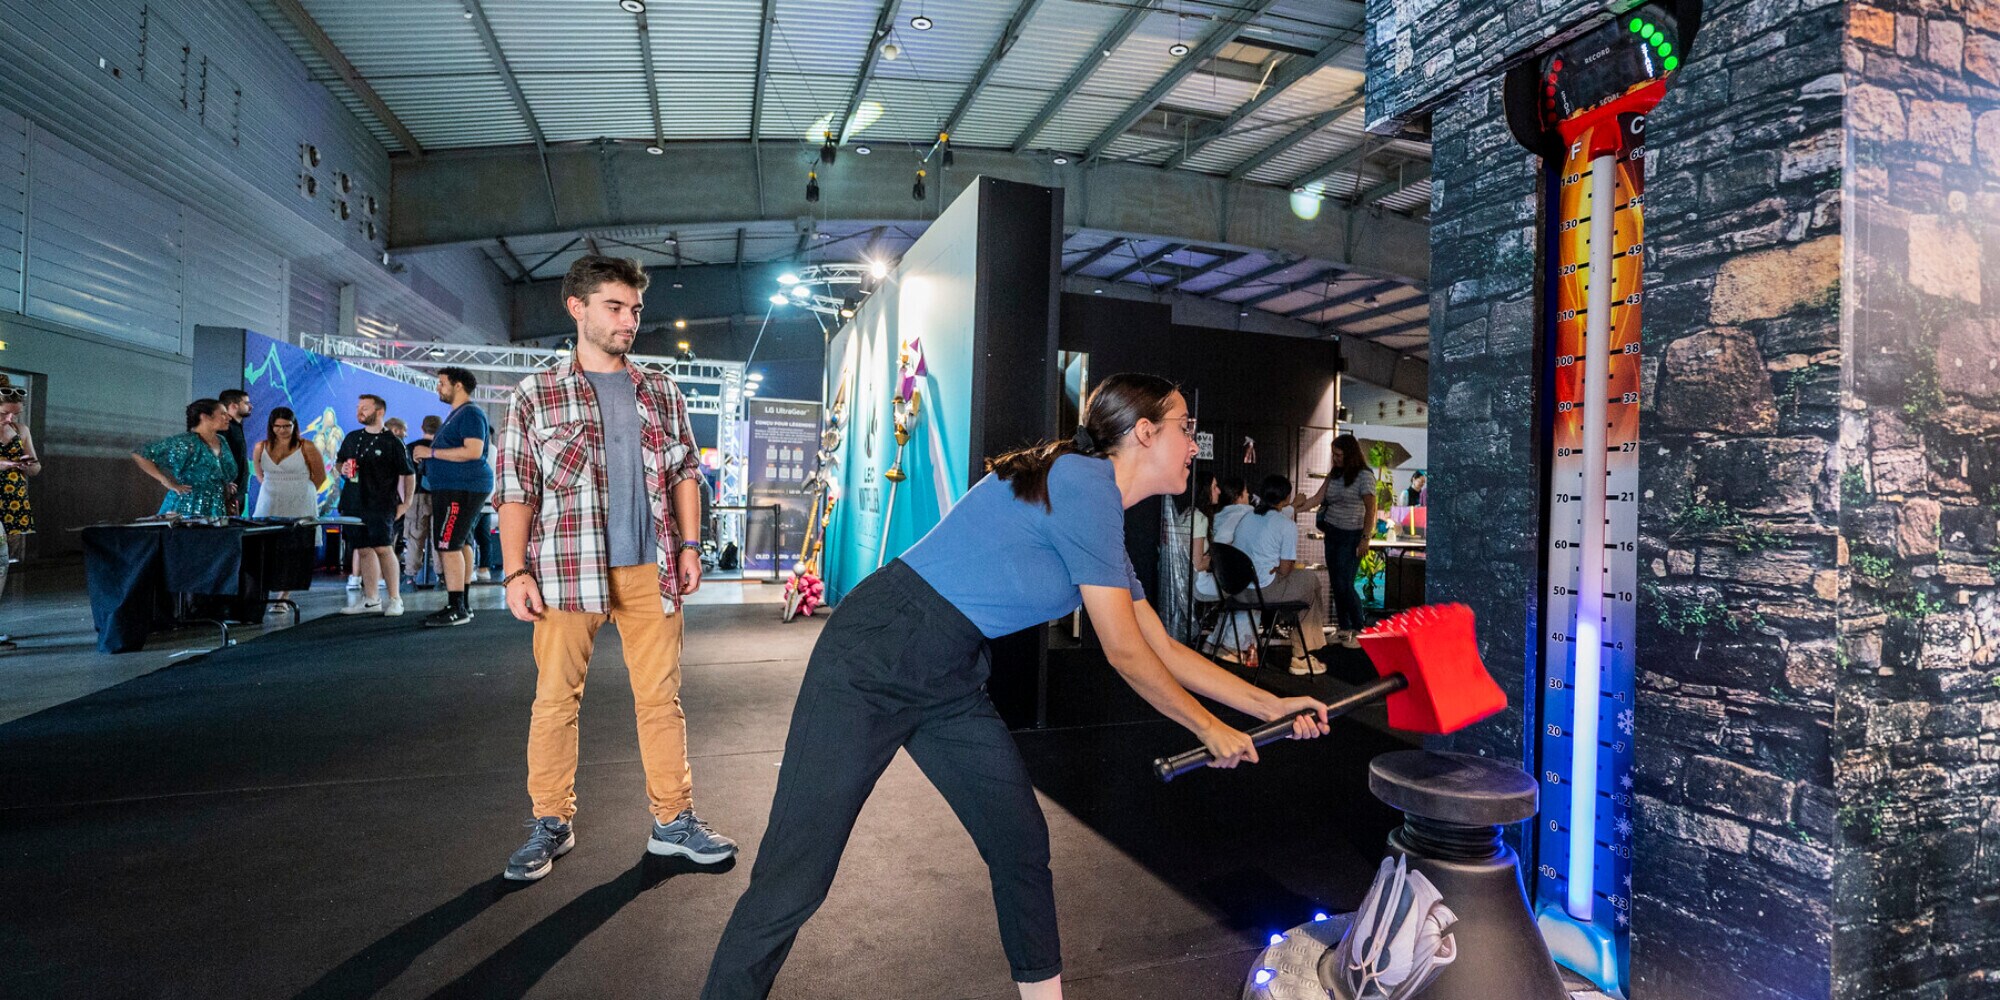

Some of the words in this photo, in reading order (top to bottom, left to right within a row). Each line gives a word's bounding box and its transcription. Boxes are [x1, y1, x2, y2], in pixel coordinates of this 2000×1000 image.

[1584, 47, 1611, 65] RECORD
[1560, 90, 1571, 115] STOP
[1630, 116, 1645, 134] C
[1571, 142, 1582, 160] F
[1630, 146, 1645, 160] 60
[1561, 173, 1580, 187] 140
[1629, 195, 1644, 208] 54
[1560, 219, 1578, 232] 130
[1627, 244, 1643, 255] 49
[1558, 264, 1576, 276] 120
[1626, 293, 1641, 305] 43
[1557, 310, 1575, 322] 110
[1625, 343, 1640, 354] 38
[1556, 355, 1574, 367] 100
[1623, 393, 1638, 404] 32
[776, 407, 806, 416] UltraGear
[1558, 402, 1572, 412] 90
[1557, 448, 1570, 457] 80
[1623, 443, 1637, 453] 27
[1556, 494, 1569, 503] 70
[1621, 492, 1635, 502] 21
[1554, 540, 1568, 549] 60
[1620, 541, 1635, 552] 16
[1553, 586, 1566, 596] 50
[1618, 592, 1633, 602] 10
[1551, 632, 1565, 642] 40
[1616, 641, 1624, 651] 4
[1550, 678, 1563, 689] 30
[1547, 725, 1561, 737] 20
[1612, 741, 1625, 753] -7
[1546, 771, 1560, 785] 10
[1611, 793, 1630, 807] -12
[1550, 820, 1558, 832] 0
[1609, 844, 1629, 858] -18
[1539, 865, 1556, 880] -10
[1608, 894, 1628, 910] -23
